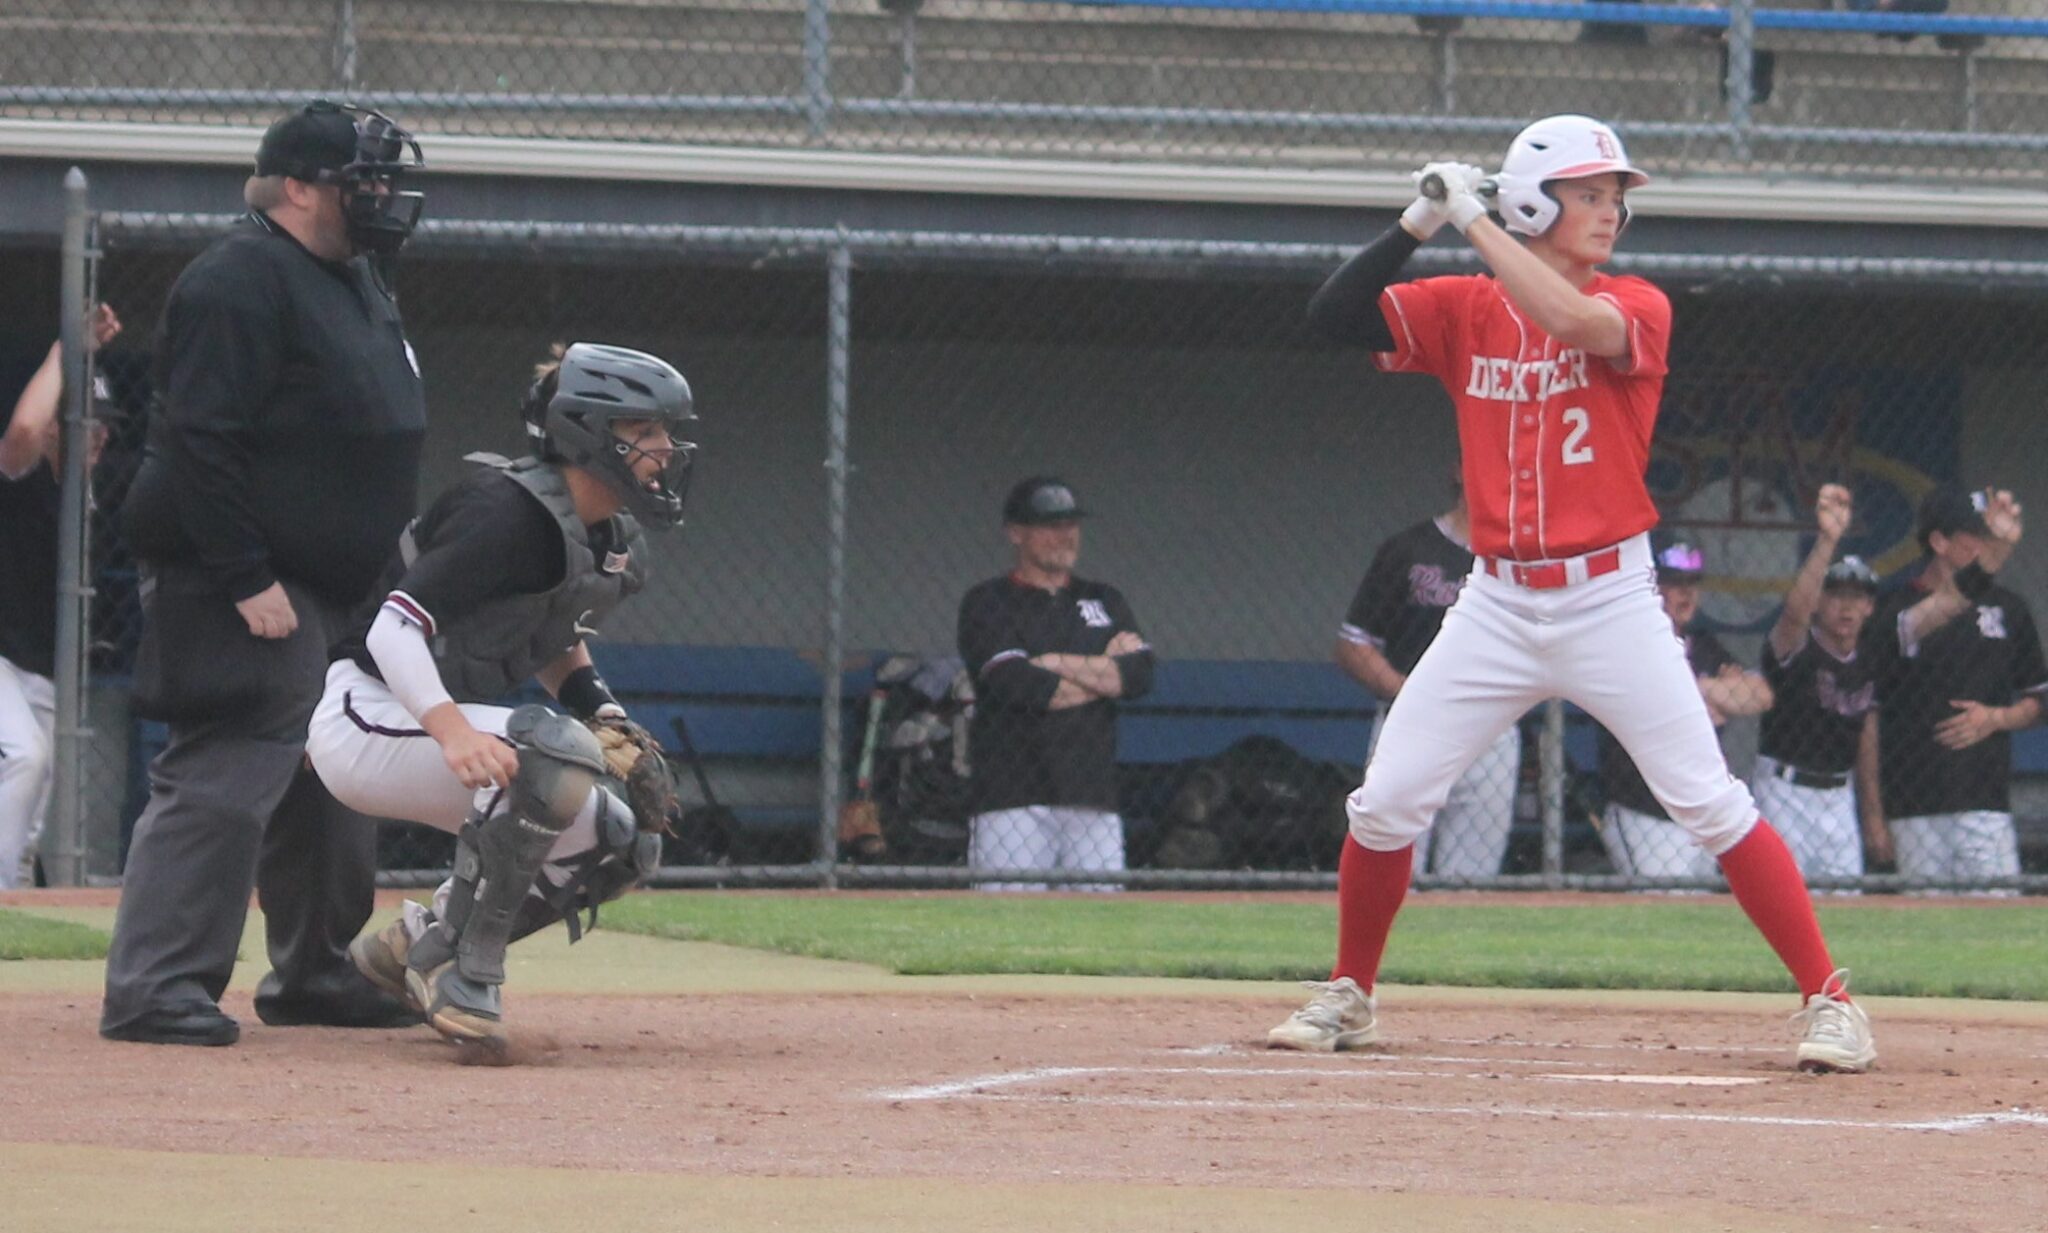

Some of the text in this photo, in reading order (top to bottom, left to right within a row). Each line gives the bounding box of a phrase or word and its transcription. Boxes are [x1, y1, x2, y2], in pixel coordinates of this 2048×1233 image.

[1590, 130, 1618, 159] D
[1465, 348, 1589, 402] DEXTER
[1561, 406, 1594, 465] 2
